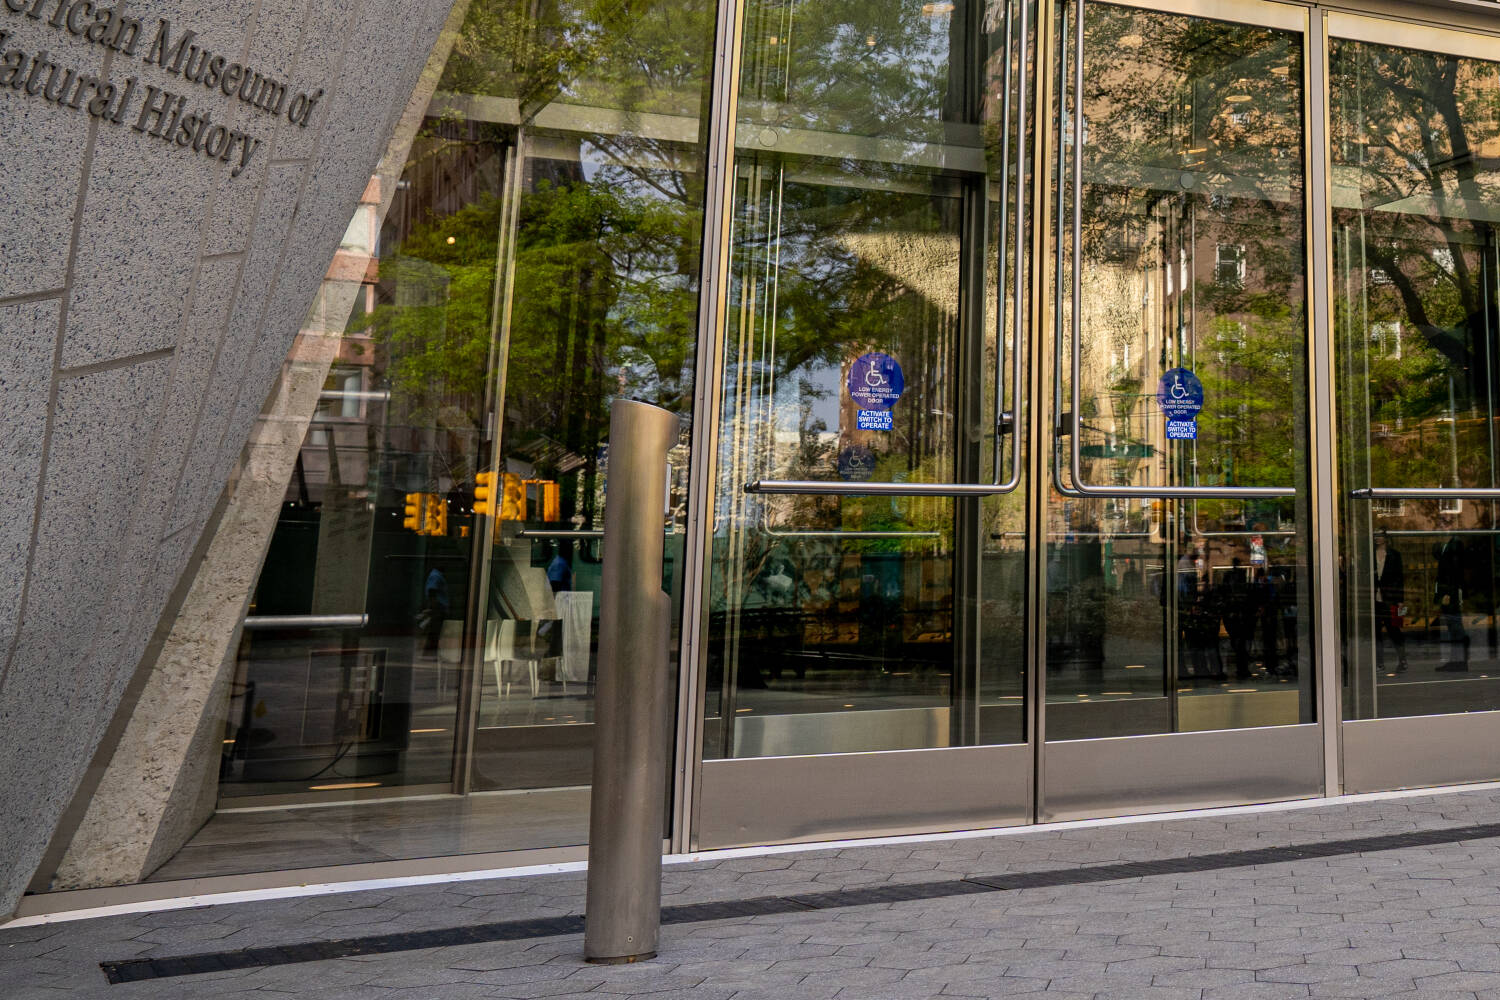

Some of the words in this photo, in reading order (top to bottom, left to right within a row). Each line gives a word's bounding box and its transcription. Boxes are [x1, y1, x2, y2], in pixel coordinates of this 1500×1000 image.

[0, 30, 138, 125] atural
[133, 84, 262, 178] History
[143, 18, 288, 117] Museum
[289, 87, 325, 128] of
